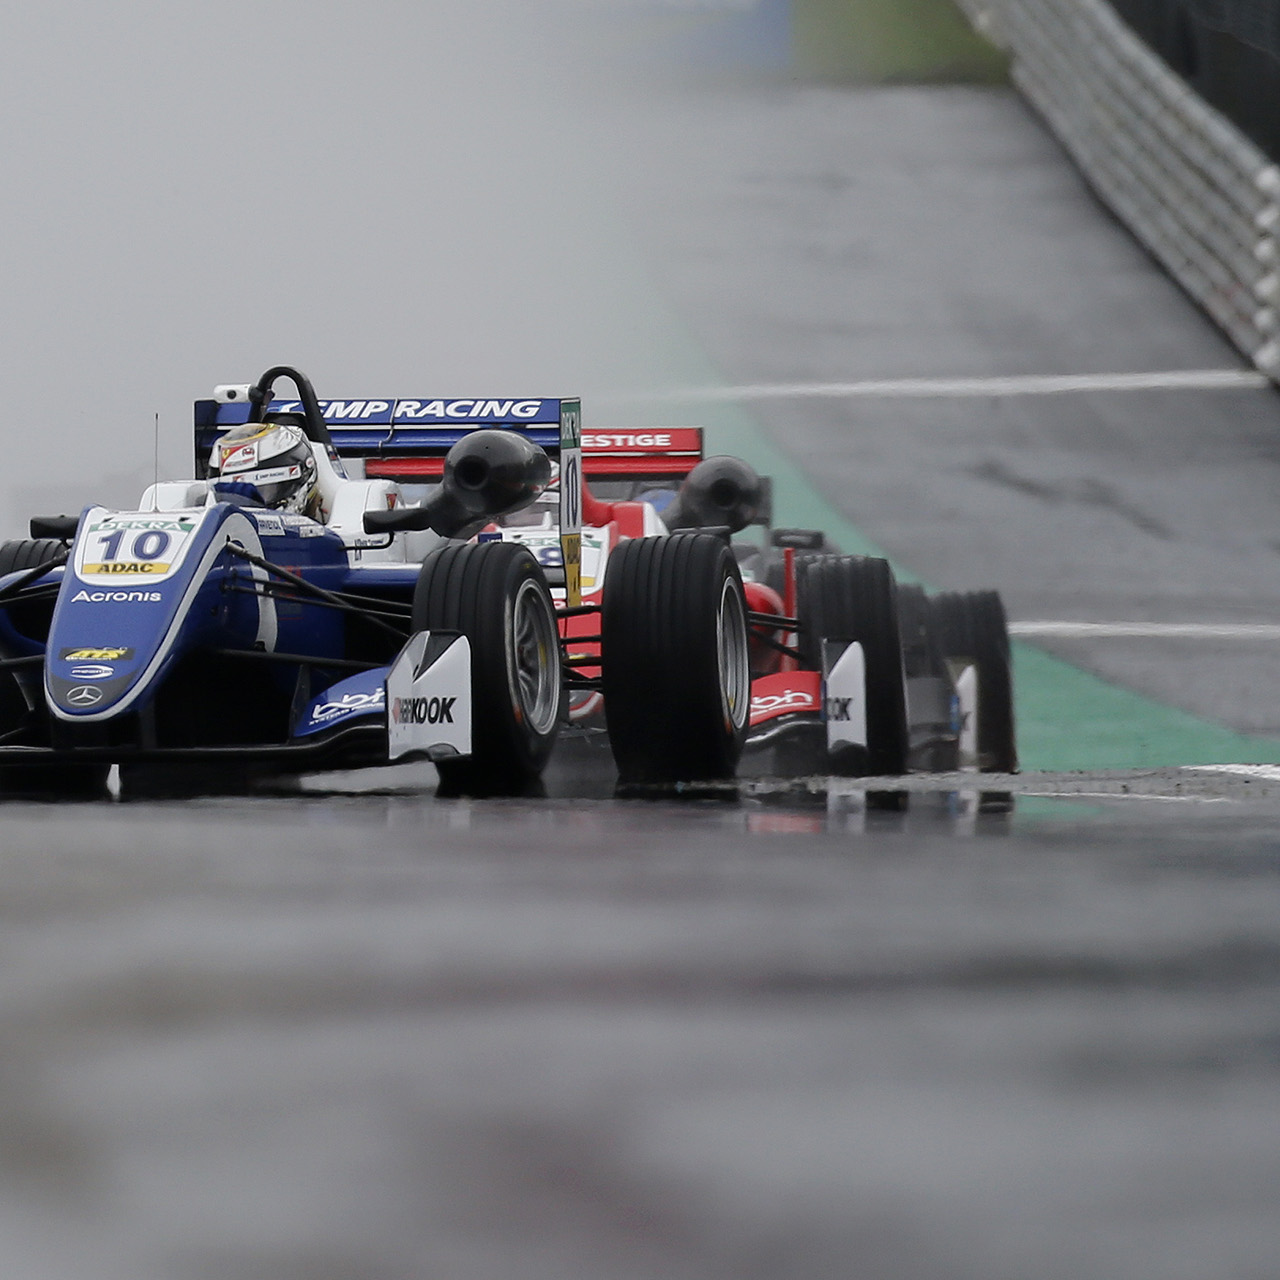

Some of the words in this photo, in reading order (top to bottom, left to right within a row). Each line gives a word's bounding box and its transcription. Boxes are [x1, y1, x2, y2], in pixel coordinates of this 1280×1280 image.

[394, 400, 541, 419] RACING
[580, 433, 672, 448] ESTIGE
[98, 522, 181, 531] DEKRA
[97, 529, 172, 562] 10
[98, 563, 154, 573] ADAC
[71, 590, 161, 602] Acronis
[313, 687, 385, 719] bbi
